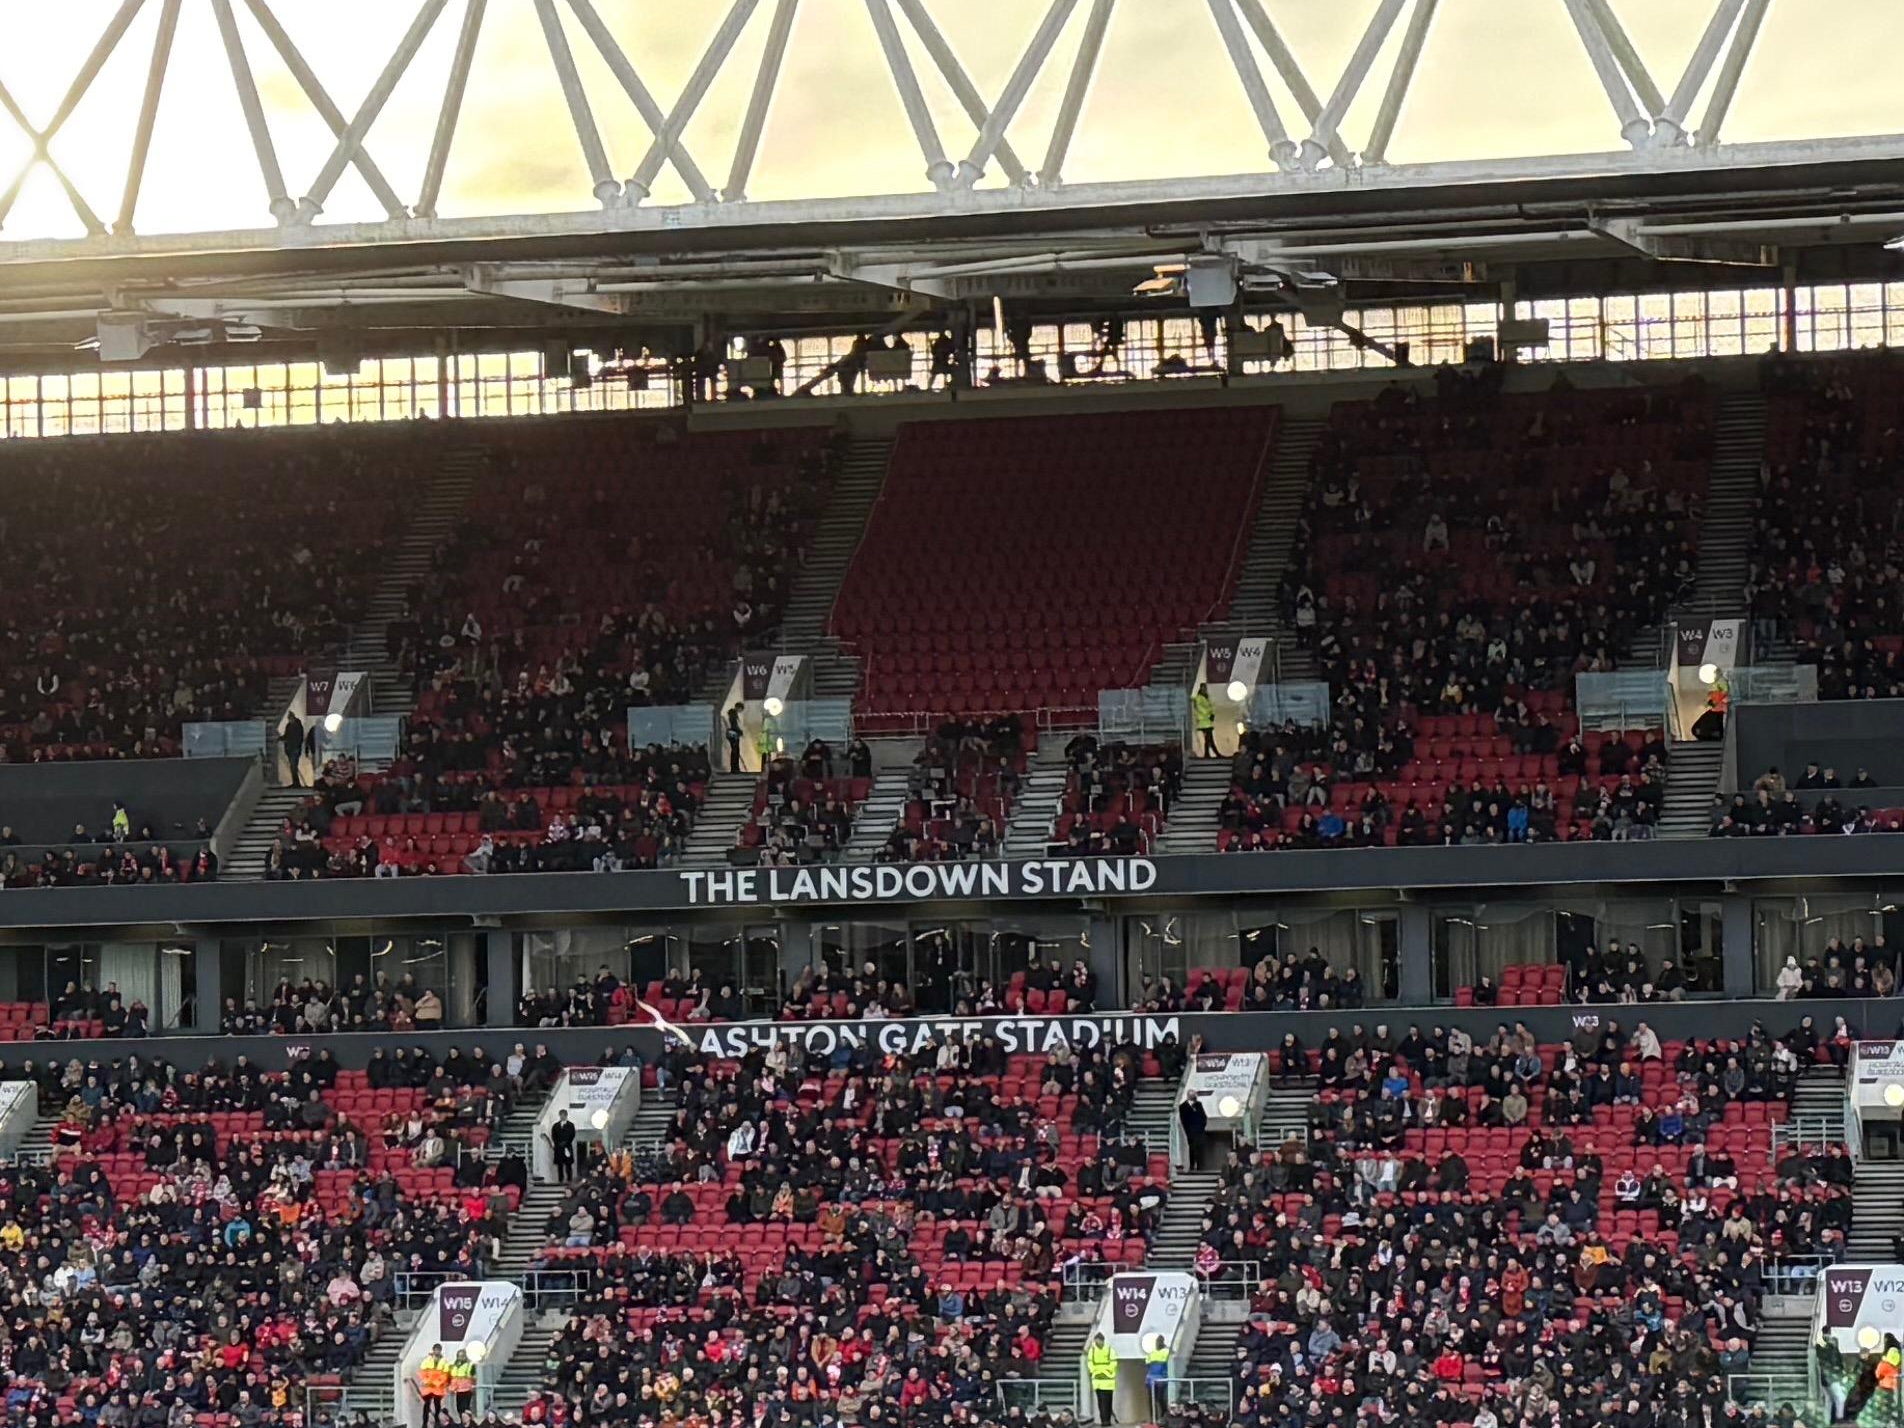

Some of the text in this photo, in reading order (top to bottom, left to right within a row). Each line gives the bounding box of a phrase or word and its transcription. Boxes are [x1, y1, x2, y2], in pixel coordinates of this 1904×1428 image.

[1680, 629, 1704, 642] W4
[1712, 628, 1733, 640] W3
[747, 665, 769, 676] W6
[310, 681, 330, 692] W7
[679, 858, 1157, 903] THE LANSDOWN STAND
[699, 1025, 866, 1059] ASHTON
[1116, 1286, 1147, 1300] W14
[1158, 1286, 1187, 1300] W13
[1830, 1280, 1863, 1294] W13
[1873, 1280, 1904, 1294] W12
